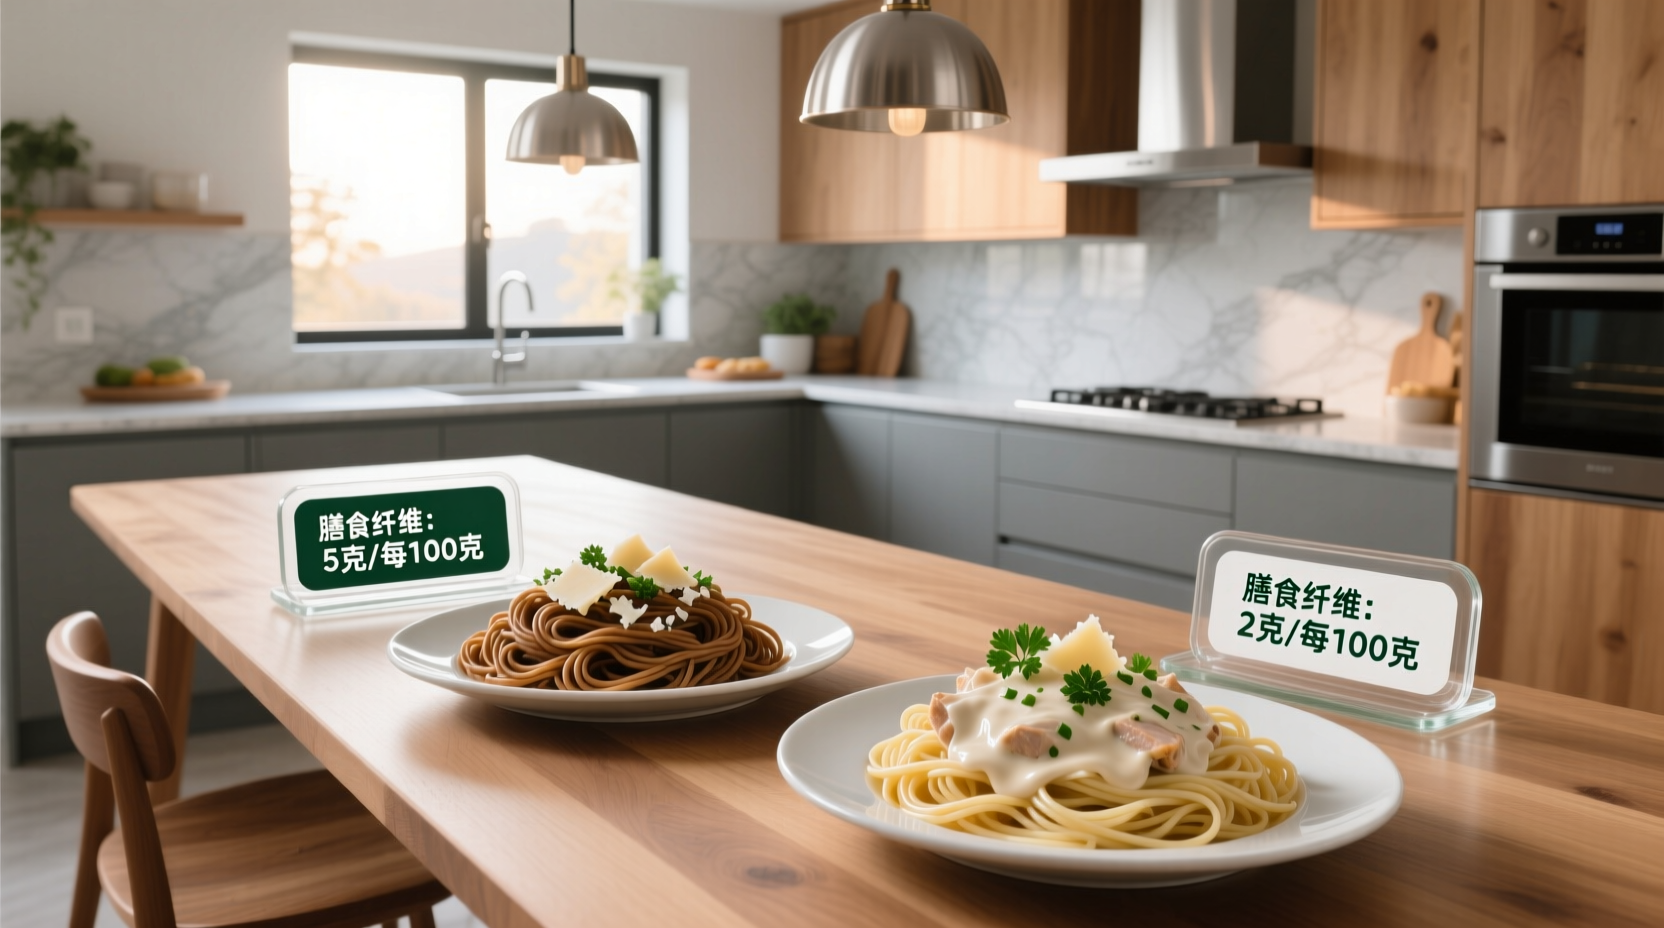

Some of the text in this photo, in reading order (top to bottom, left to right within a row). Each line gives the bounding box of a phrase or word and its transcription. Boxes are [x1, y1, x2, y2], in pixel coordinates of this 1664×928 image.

[319, 507, 434, 542] 膳食纤维：
[323, 533, 484, 574] 5克/每100克
[1242, 572, 1374, 620] 膳食纤维：
[1237, 611, 1420, 671] 2克/每100克
